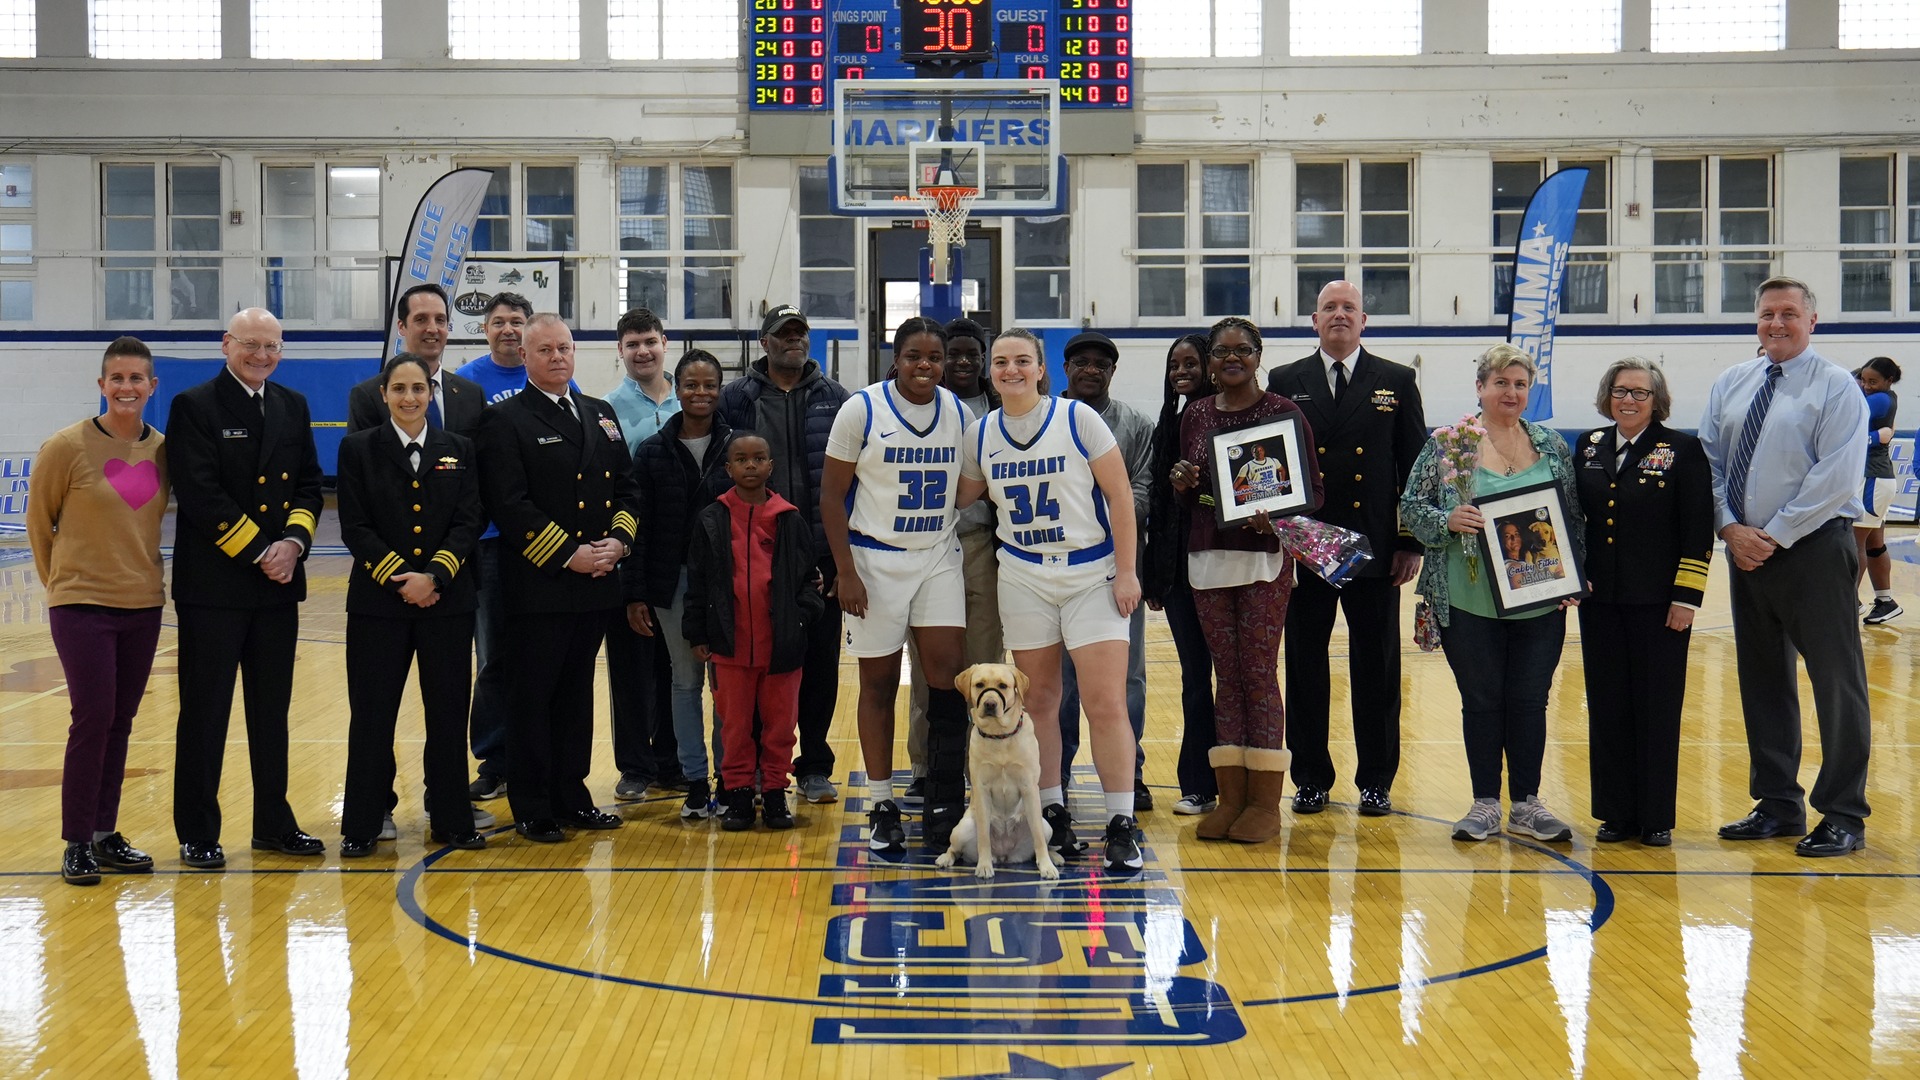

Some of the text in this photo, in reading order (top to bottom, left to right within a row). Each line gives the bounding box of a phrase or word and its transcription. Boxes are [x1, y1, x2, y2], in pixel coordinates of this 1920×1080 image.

[832, 10, 887, 22] KINGS POINT
[996, 10, 1048, 22] GUEST
[1066, 16, 1128, 31] 11 0 0
[755, 17, 823, 33] 23 0 0
[923, 8, 973, 51] 30
[865, 25, 881, 52] 0
[1027, 25, 1044, 52] 0
[755, 41, 823, 57] 24 0 0
[1066, 39, 1128, 55] 12 0 0
[833, 55, 868, 64] FOULS
[1014, 54, 1049, 63] FOULS
[756, 64, 823, 80] 33 0 0
[1060, 63, 1128, 79] 22 0 0
[756, 87, 823, 104] 34 0 0
[1060, 86, 1128, 102] 44 0 0
[831, 119, 1050, 146] MARINERS
[1511, 235, 1554, 363] SMMA
[883, 447, 955, 464] MERCHANT
[991, 455, 1066, 480] MERCHANT
[897, 470, 948, 510] 32
[1003, 481, 1060, 525] 34
[893, 515, 944, 532] MARINE
[1013, 526, 1066, 546] MARINE
[1508, 564, 1535, 577] Gabby
